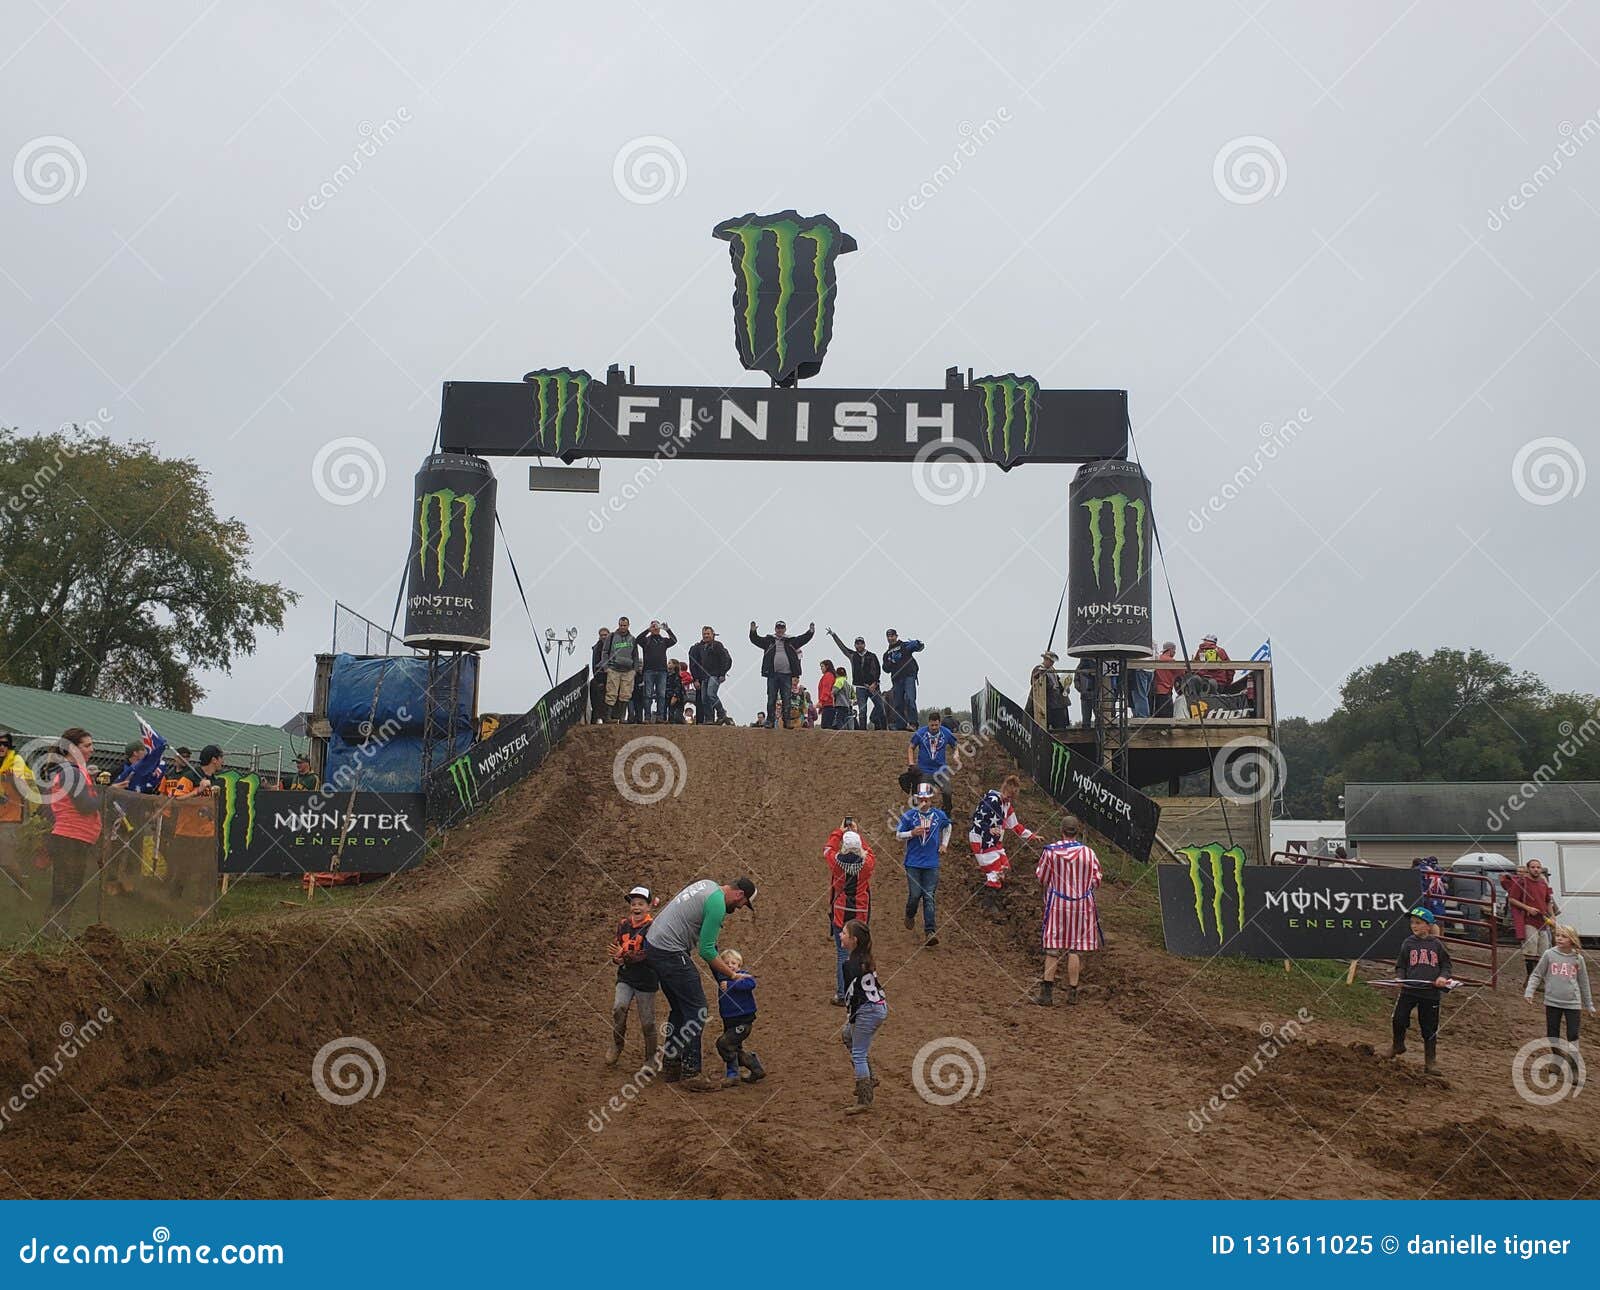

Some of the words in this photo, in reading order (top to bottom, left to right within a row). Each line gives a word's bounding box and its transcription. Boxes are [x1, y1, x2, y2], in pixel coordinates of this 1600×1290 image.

[616, 396, 954, 442] FINISH
[1077, 602, 1149, 619] MONSTER
[478, 733, 529, 775] MONSTER
[1072, 770, 1131, 820] MONSTER
[1078, 793, 1121, 824] ENERGY
[274, 809, 412, 832] MONSTER
[295, 837, 392, 846] ENERGY
[1264, 887, 1410, 914] MONSTER
[1289, 919, 1388, 929] ENERGY
